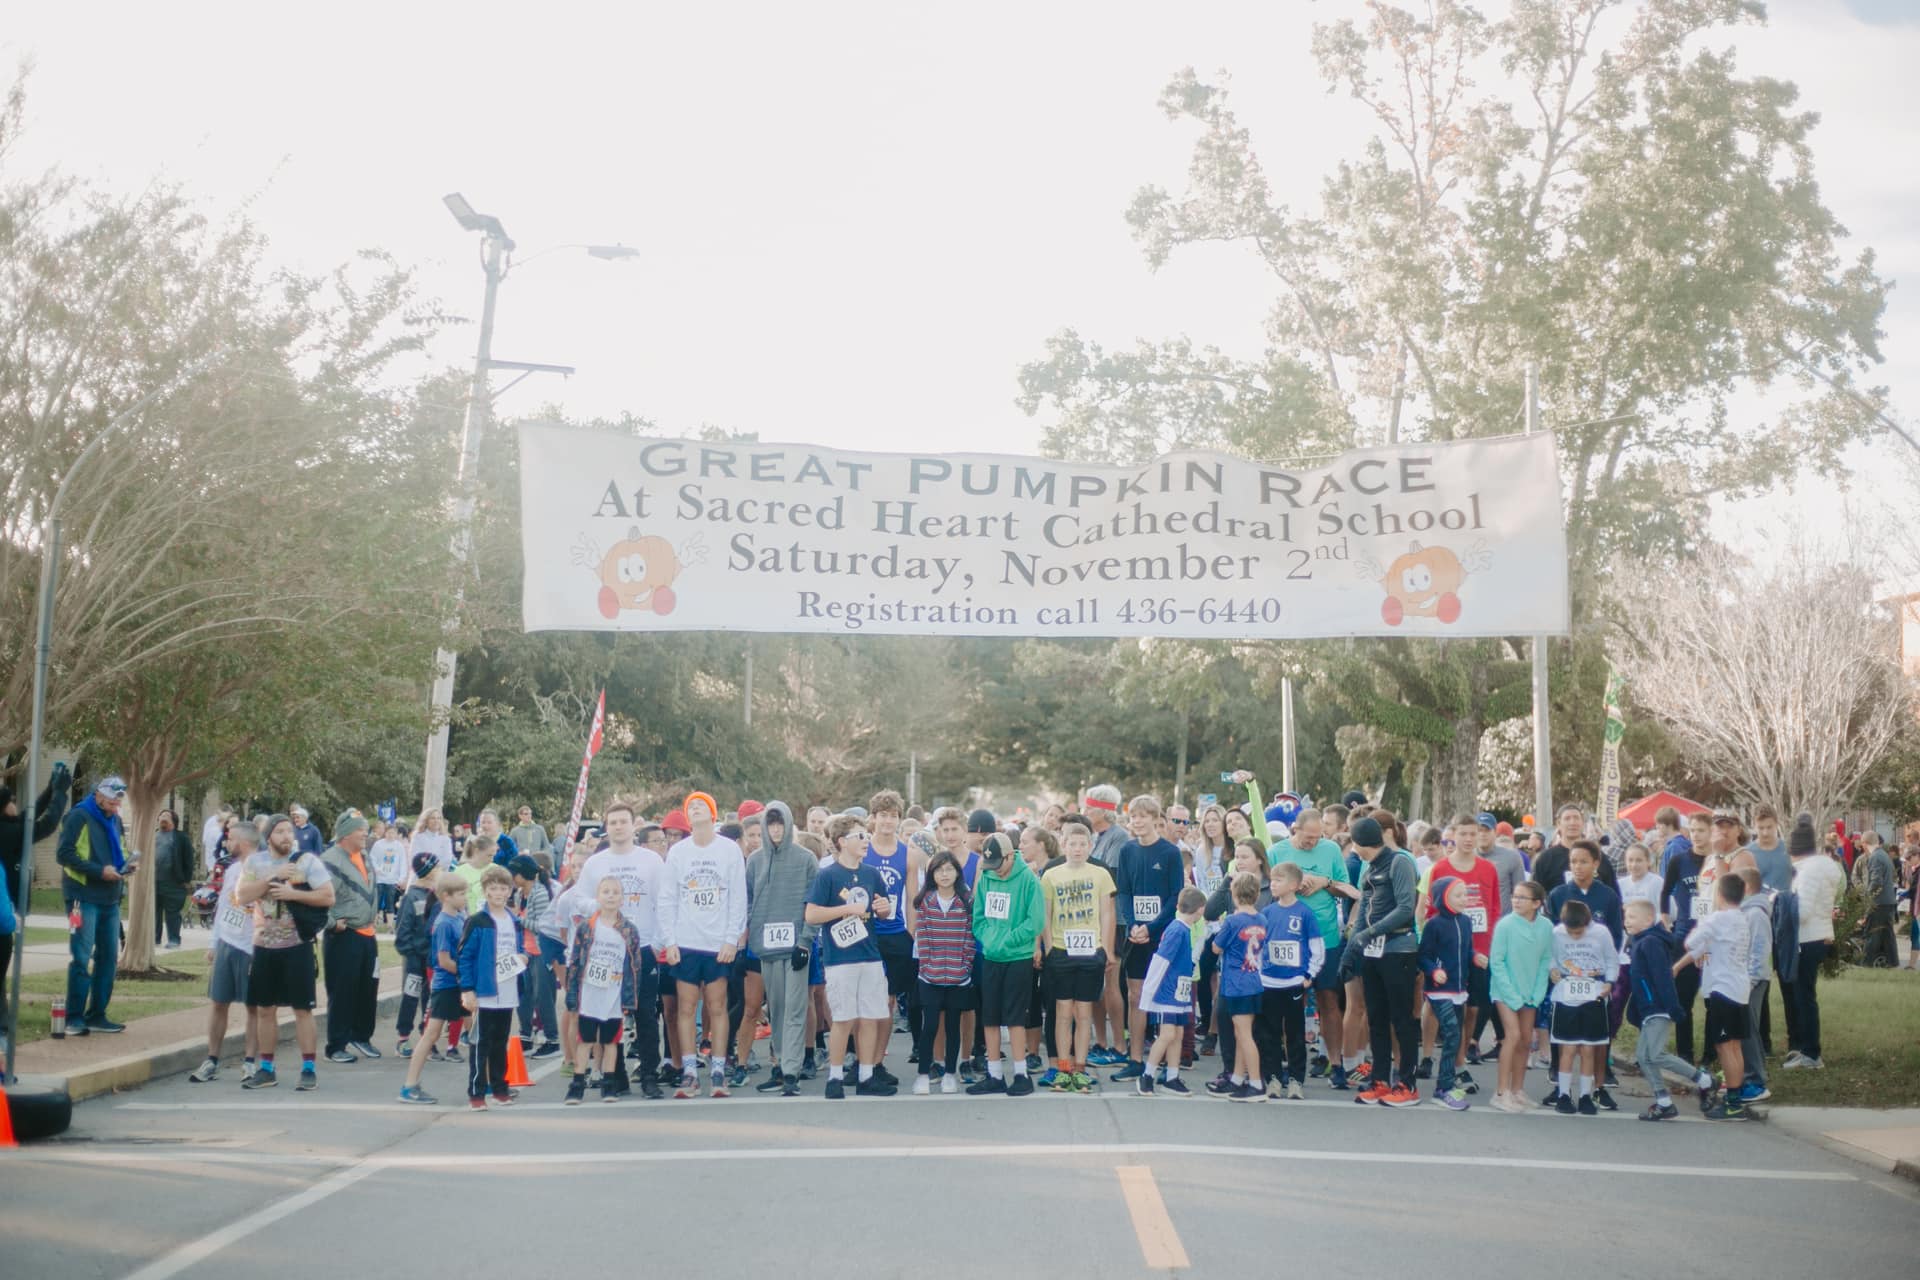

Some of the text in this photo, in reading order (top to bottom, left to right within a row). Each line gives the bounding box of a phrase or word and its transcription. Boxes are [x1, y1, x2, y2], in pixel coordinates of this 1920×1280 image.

[639, 442, 1436, 508] GREAT PUMPKIN RACE
[592, 479, 1487, 549] At Sacred Heart Cathedral School
[727, 532, 1350, 594] Saturday, November 2nd
[797, 591, 1282, 629] Registration call 436-6440
[694, 891, 715, 906] 492
[1135, 902, 1159, 914] 1250
[769, 928, 790, 942] 142
[838, 921, 859, 942] 657
[1066, 936, 1094, 949] 1221
[1274, 946, 1294, 960] 836
[589, 963, 608, 981] 658
